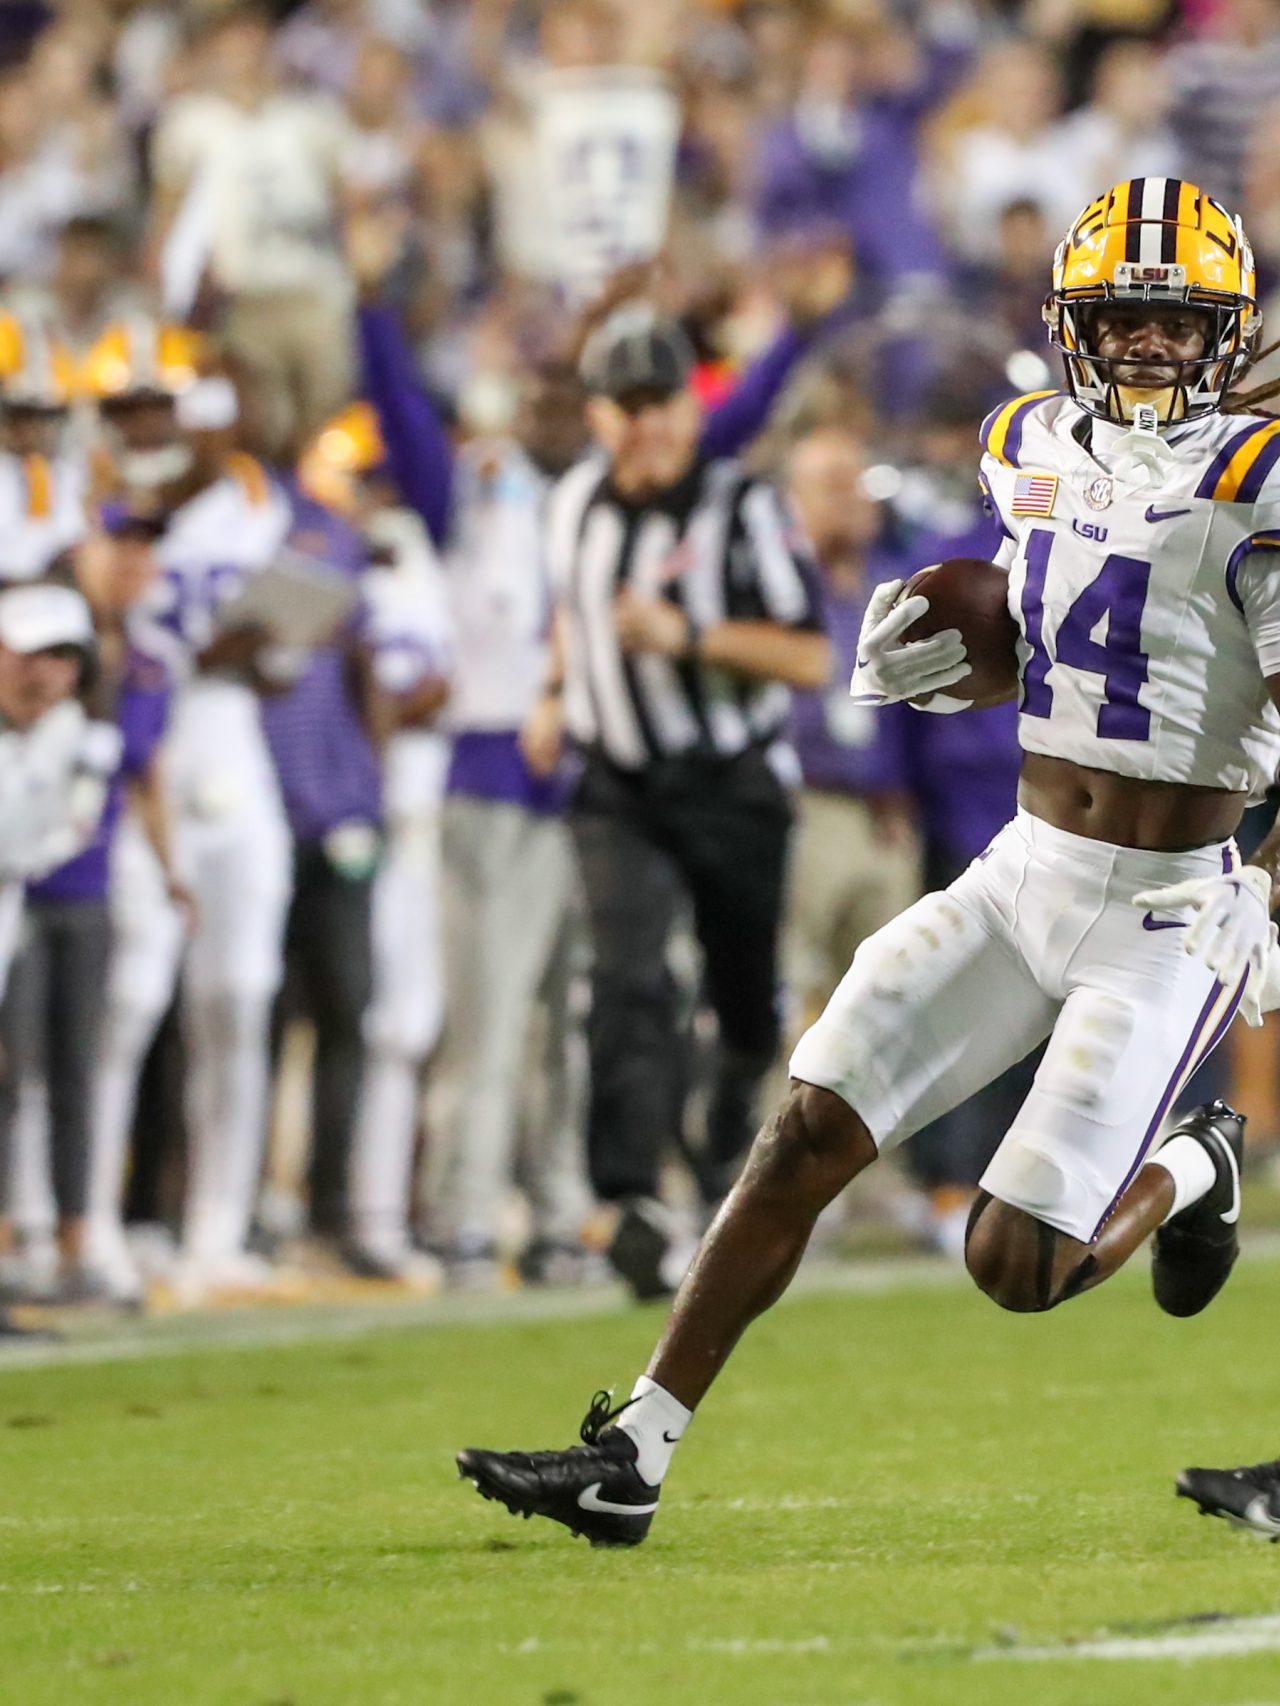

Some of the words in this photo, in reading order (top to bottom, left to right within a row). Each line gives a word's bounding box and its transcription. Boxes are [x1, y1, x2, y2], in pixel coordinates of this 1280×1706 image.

[1131, 267, 1168, 281] LSU
[1072, 518, 1109, 543] LSU
[1019, 528, 1152, 741] 14
